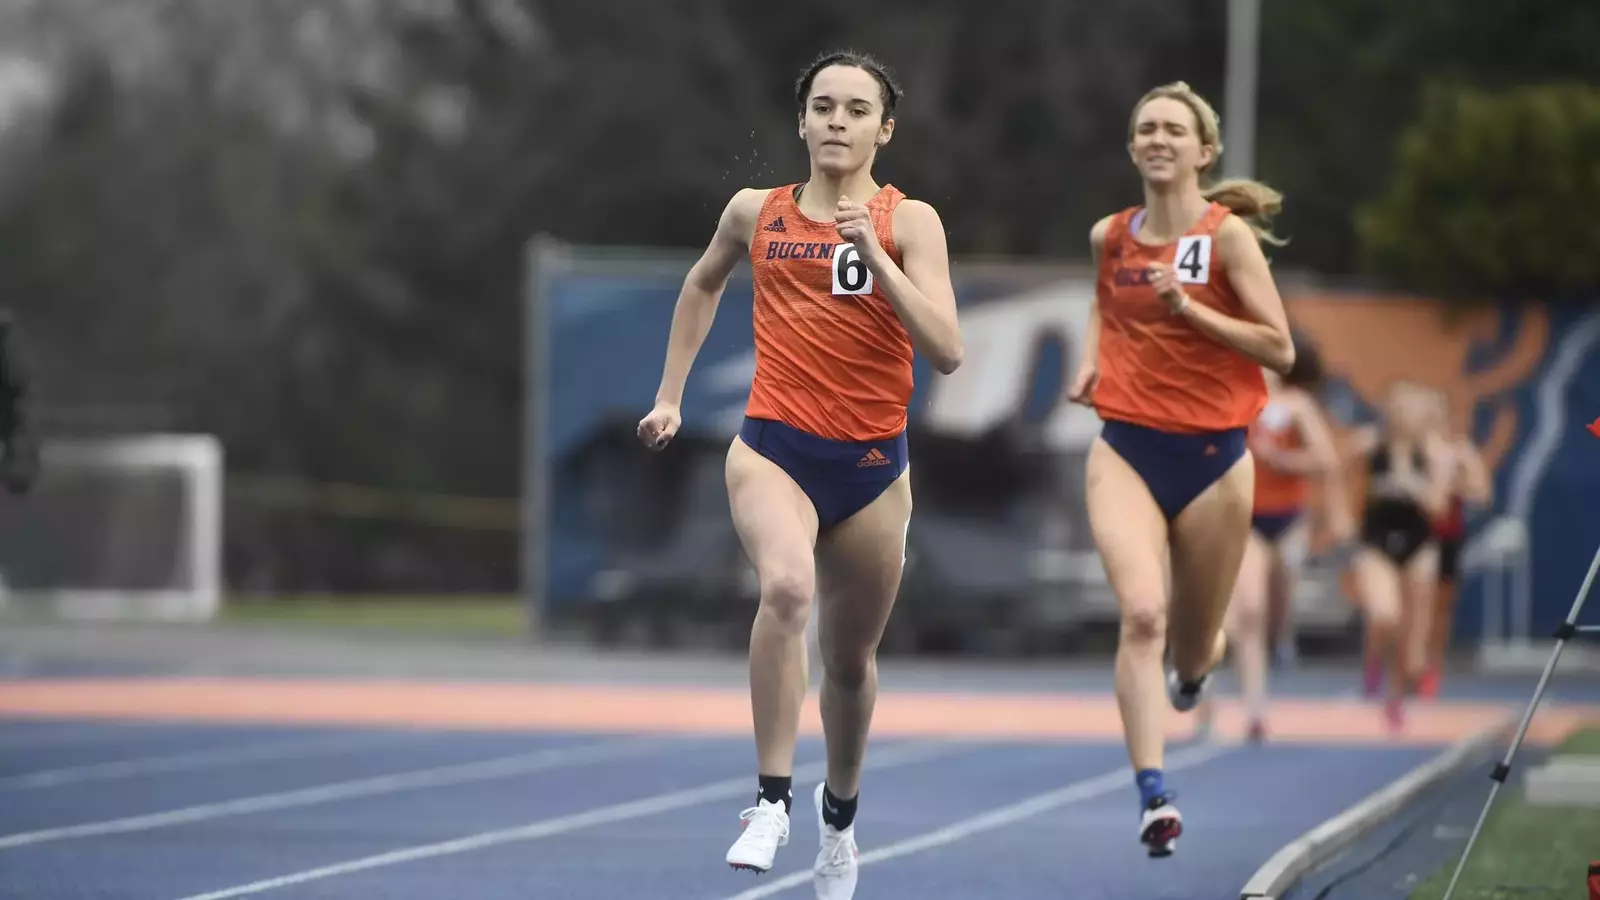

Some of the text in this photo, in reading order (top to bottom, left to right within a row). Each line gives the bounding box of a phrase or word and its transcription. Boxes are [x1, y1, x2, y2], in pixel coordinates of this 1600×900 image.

[766, 241, 841, 260] BUCKN
[1178, 240, 1203, 279] 4
[837, 246, 868, 291] 6
[856, 458, 891, 468] adidas
